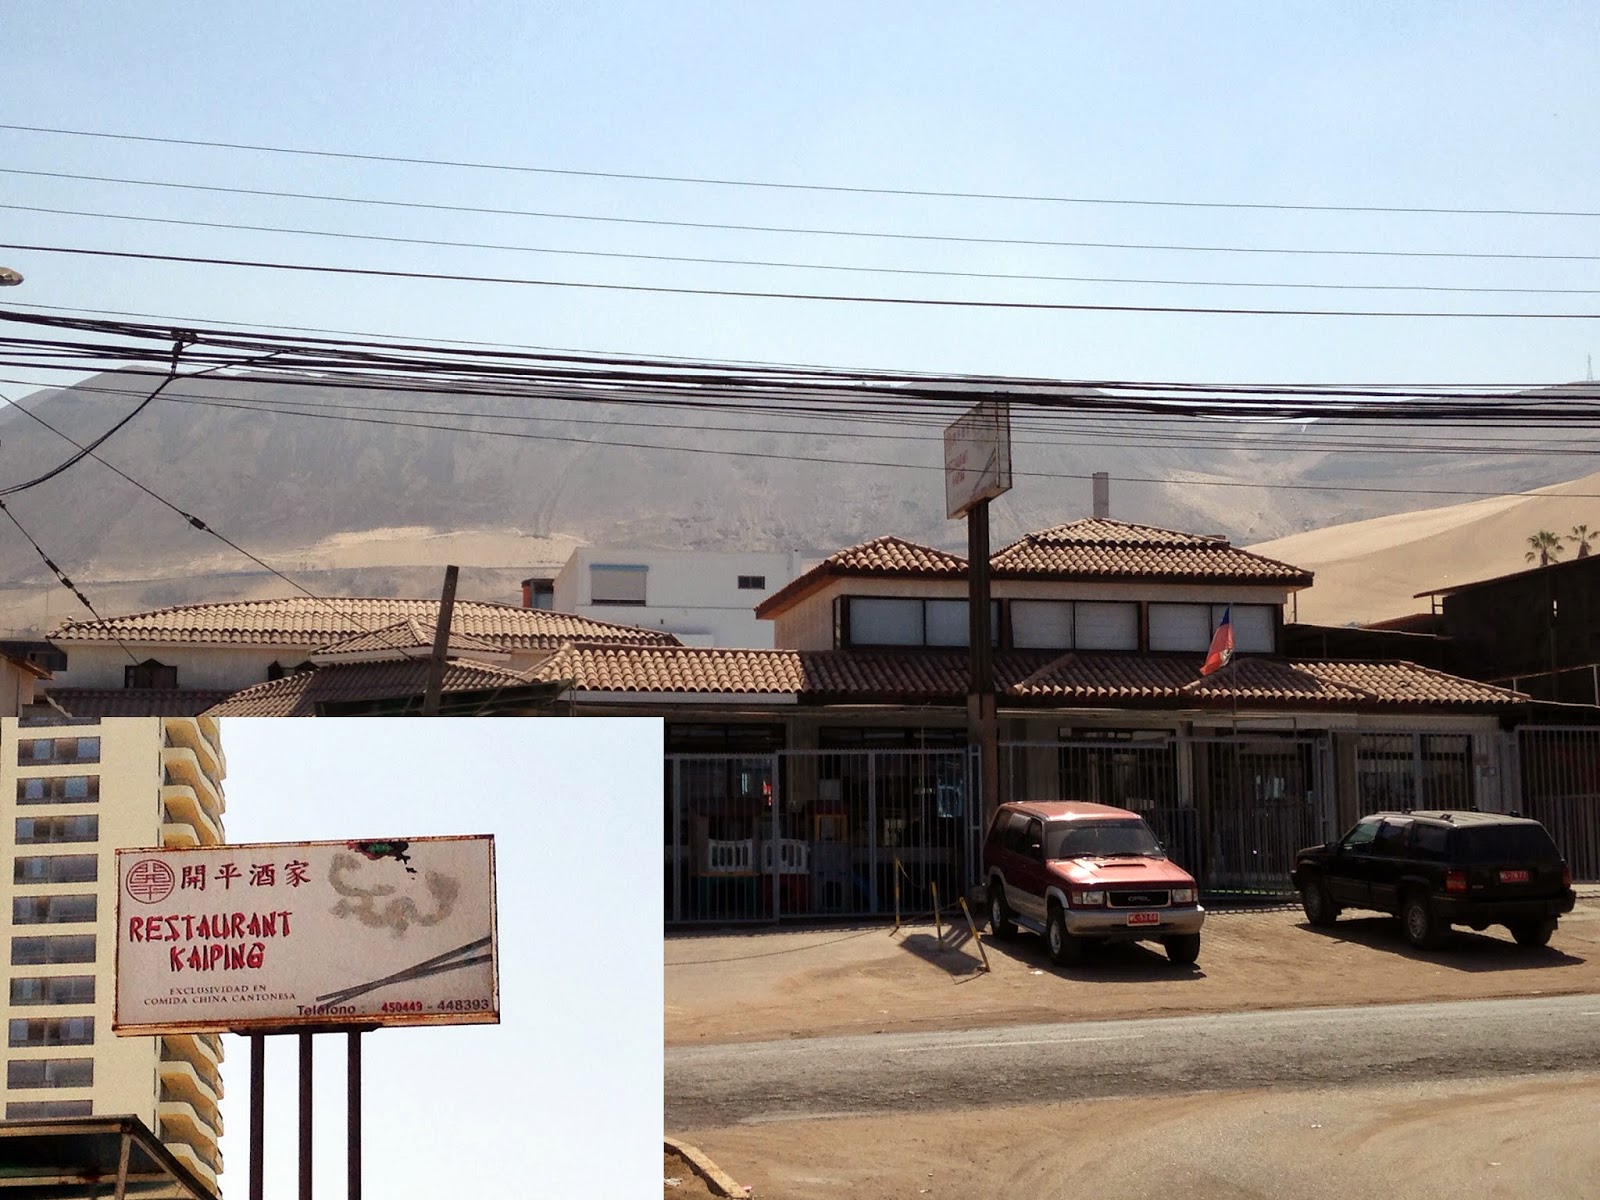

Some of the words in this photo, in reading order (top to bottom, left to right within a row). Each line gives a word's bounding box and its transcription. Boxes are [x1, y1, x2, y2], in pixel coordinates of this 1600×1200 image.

[181, 860, 311, 891] 開平酒家
[129, 910, 293, 943] RESTAURANT
[170, 942, 266, 972] KAIPING
[144, 997, 188, 1006] COMIDA
[192, 995, 228, 1004] CHINA
[231, 993, 296, 1003] CANTONESA
[169, 985, 249, 996] EXCLUSIVIDAD
[253, 984, 267, 992] EN
[381, 1001, 423, 1013] 450449
[437, 998, 490, 1012] 448393
